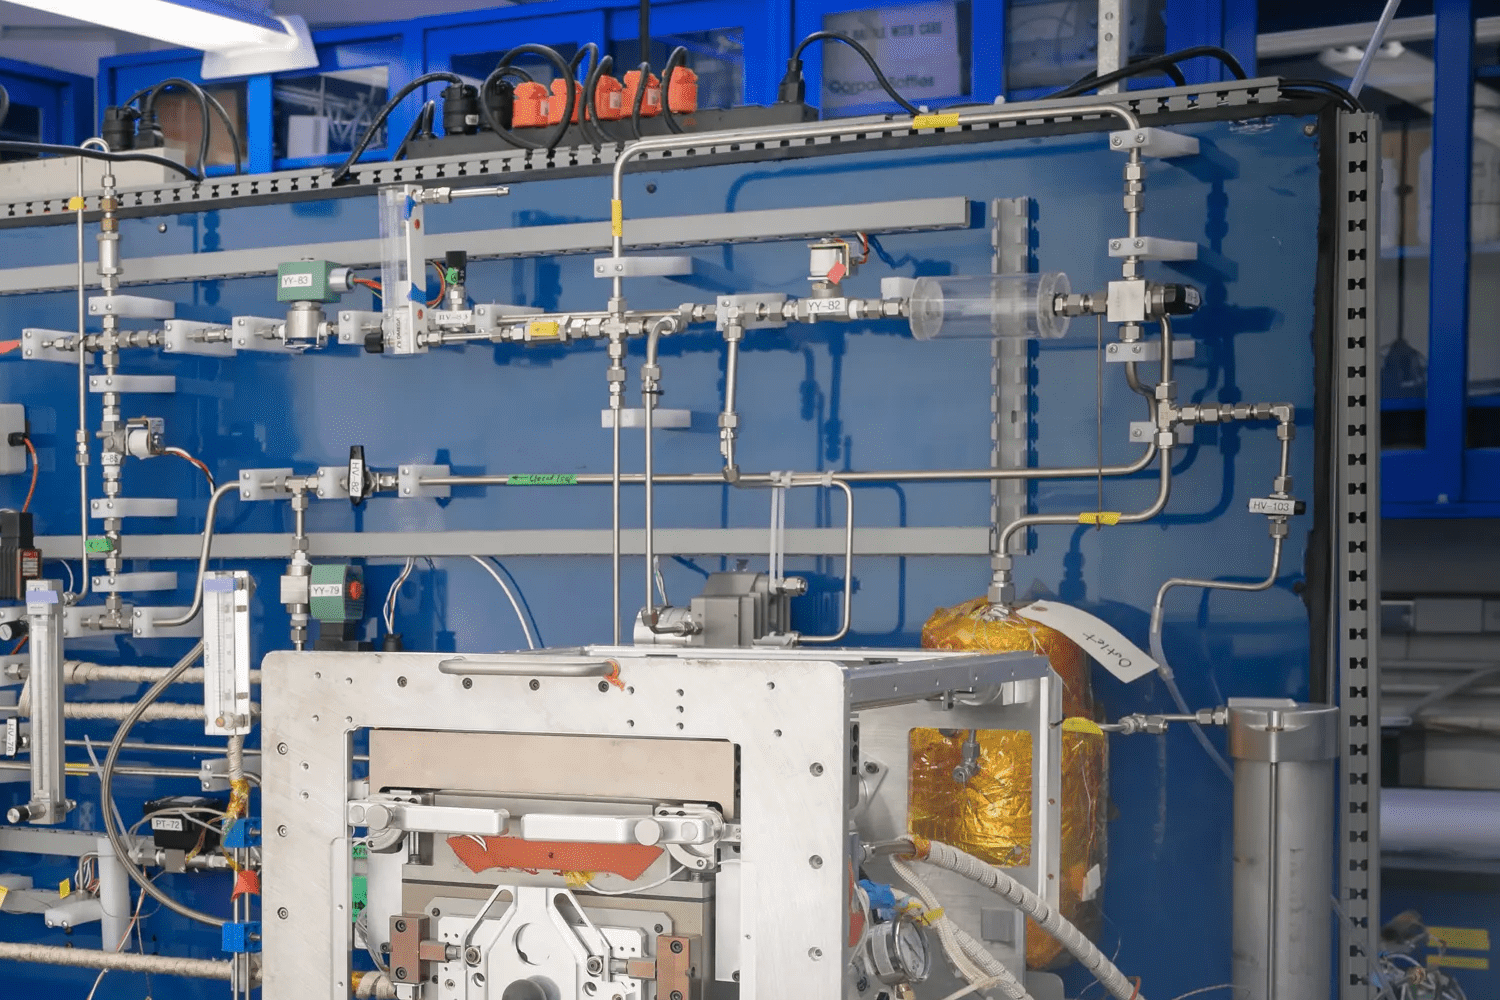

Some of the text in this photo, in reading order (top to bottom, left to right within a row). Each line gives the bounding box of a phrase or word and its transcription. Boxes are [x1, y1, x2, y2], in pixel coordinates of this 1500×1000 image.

[351, 462, 361, 494] HV-82
[1254, 502, 1289, 512] HV-103
[313, 586, 340, 595] YY-79
[1082, 632, 1132, 668] Outlet
[156, 820, 180, 829] PT-72
